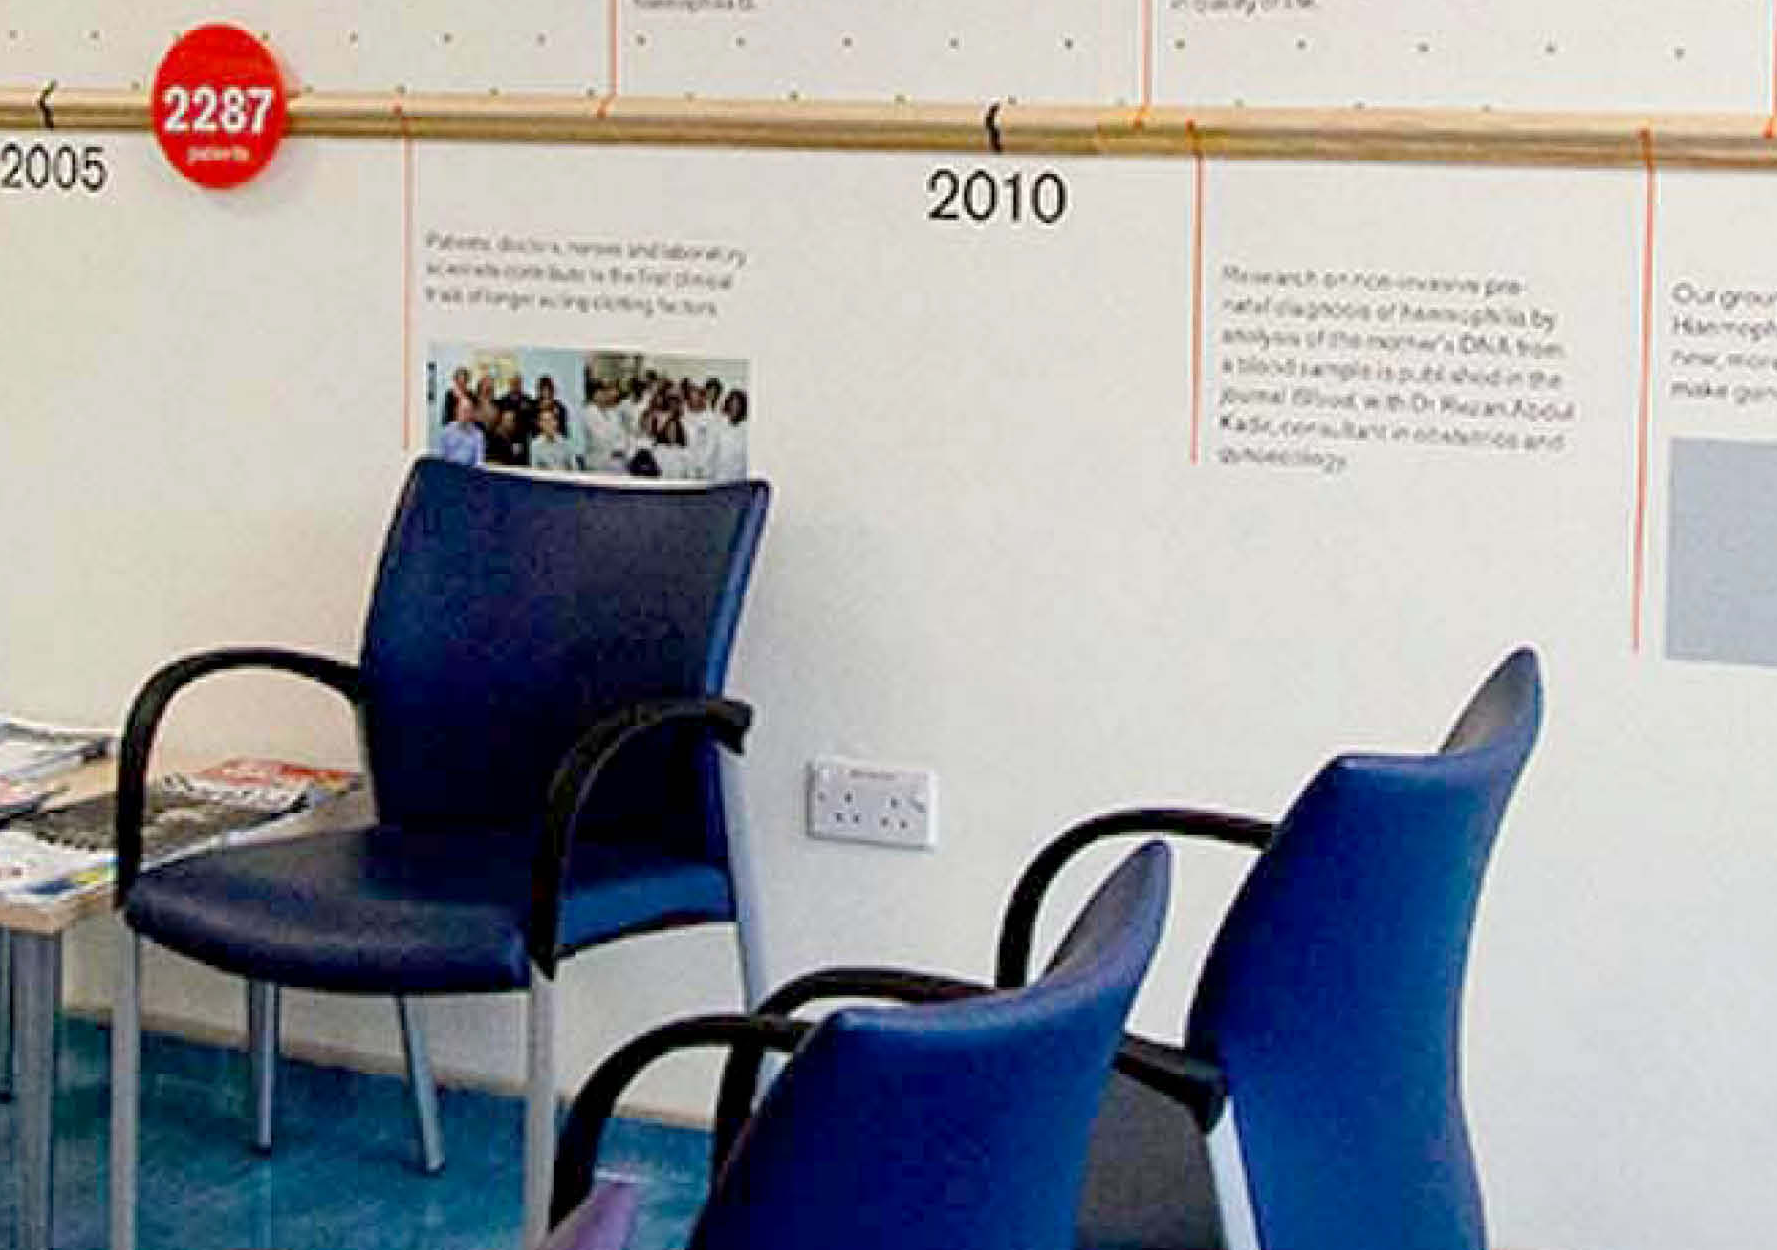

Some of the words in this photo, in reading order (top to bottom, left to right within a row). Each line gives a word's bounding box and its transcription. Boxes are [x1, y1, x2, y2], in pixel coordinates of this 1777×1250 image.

[163, 85, 274, 134] 2287
[0, 141, 105, 194] 2005
[927, 168, 1068, 226] 2010
